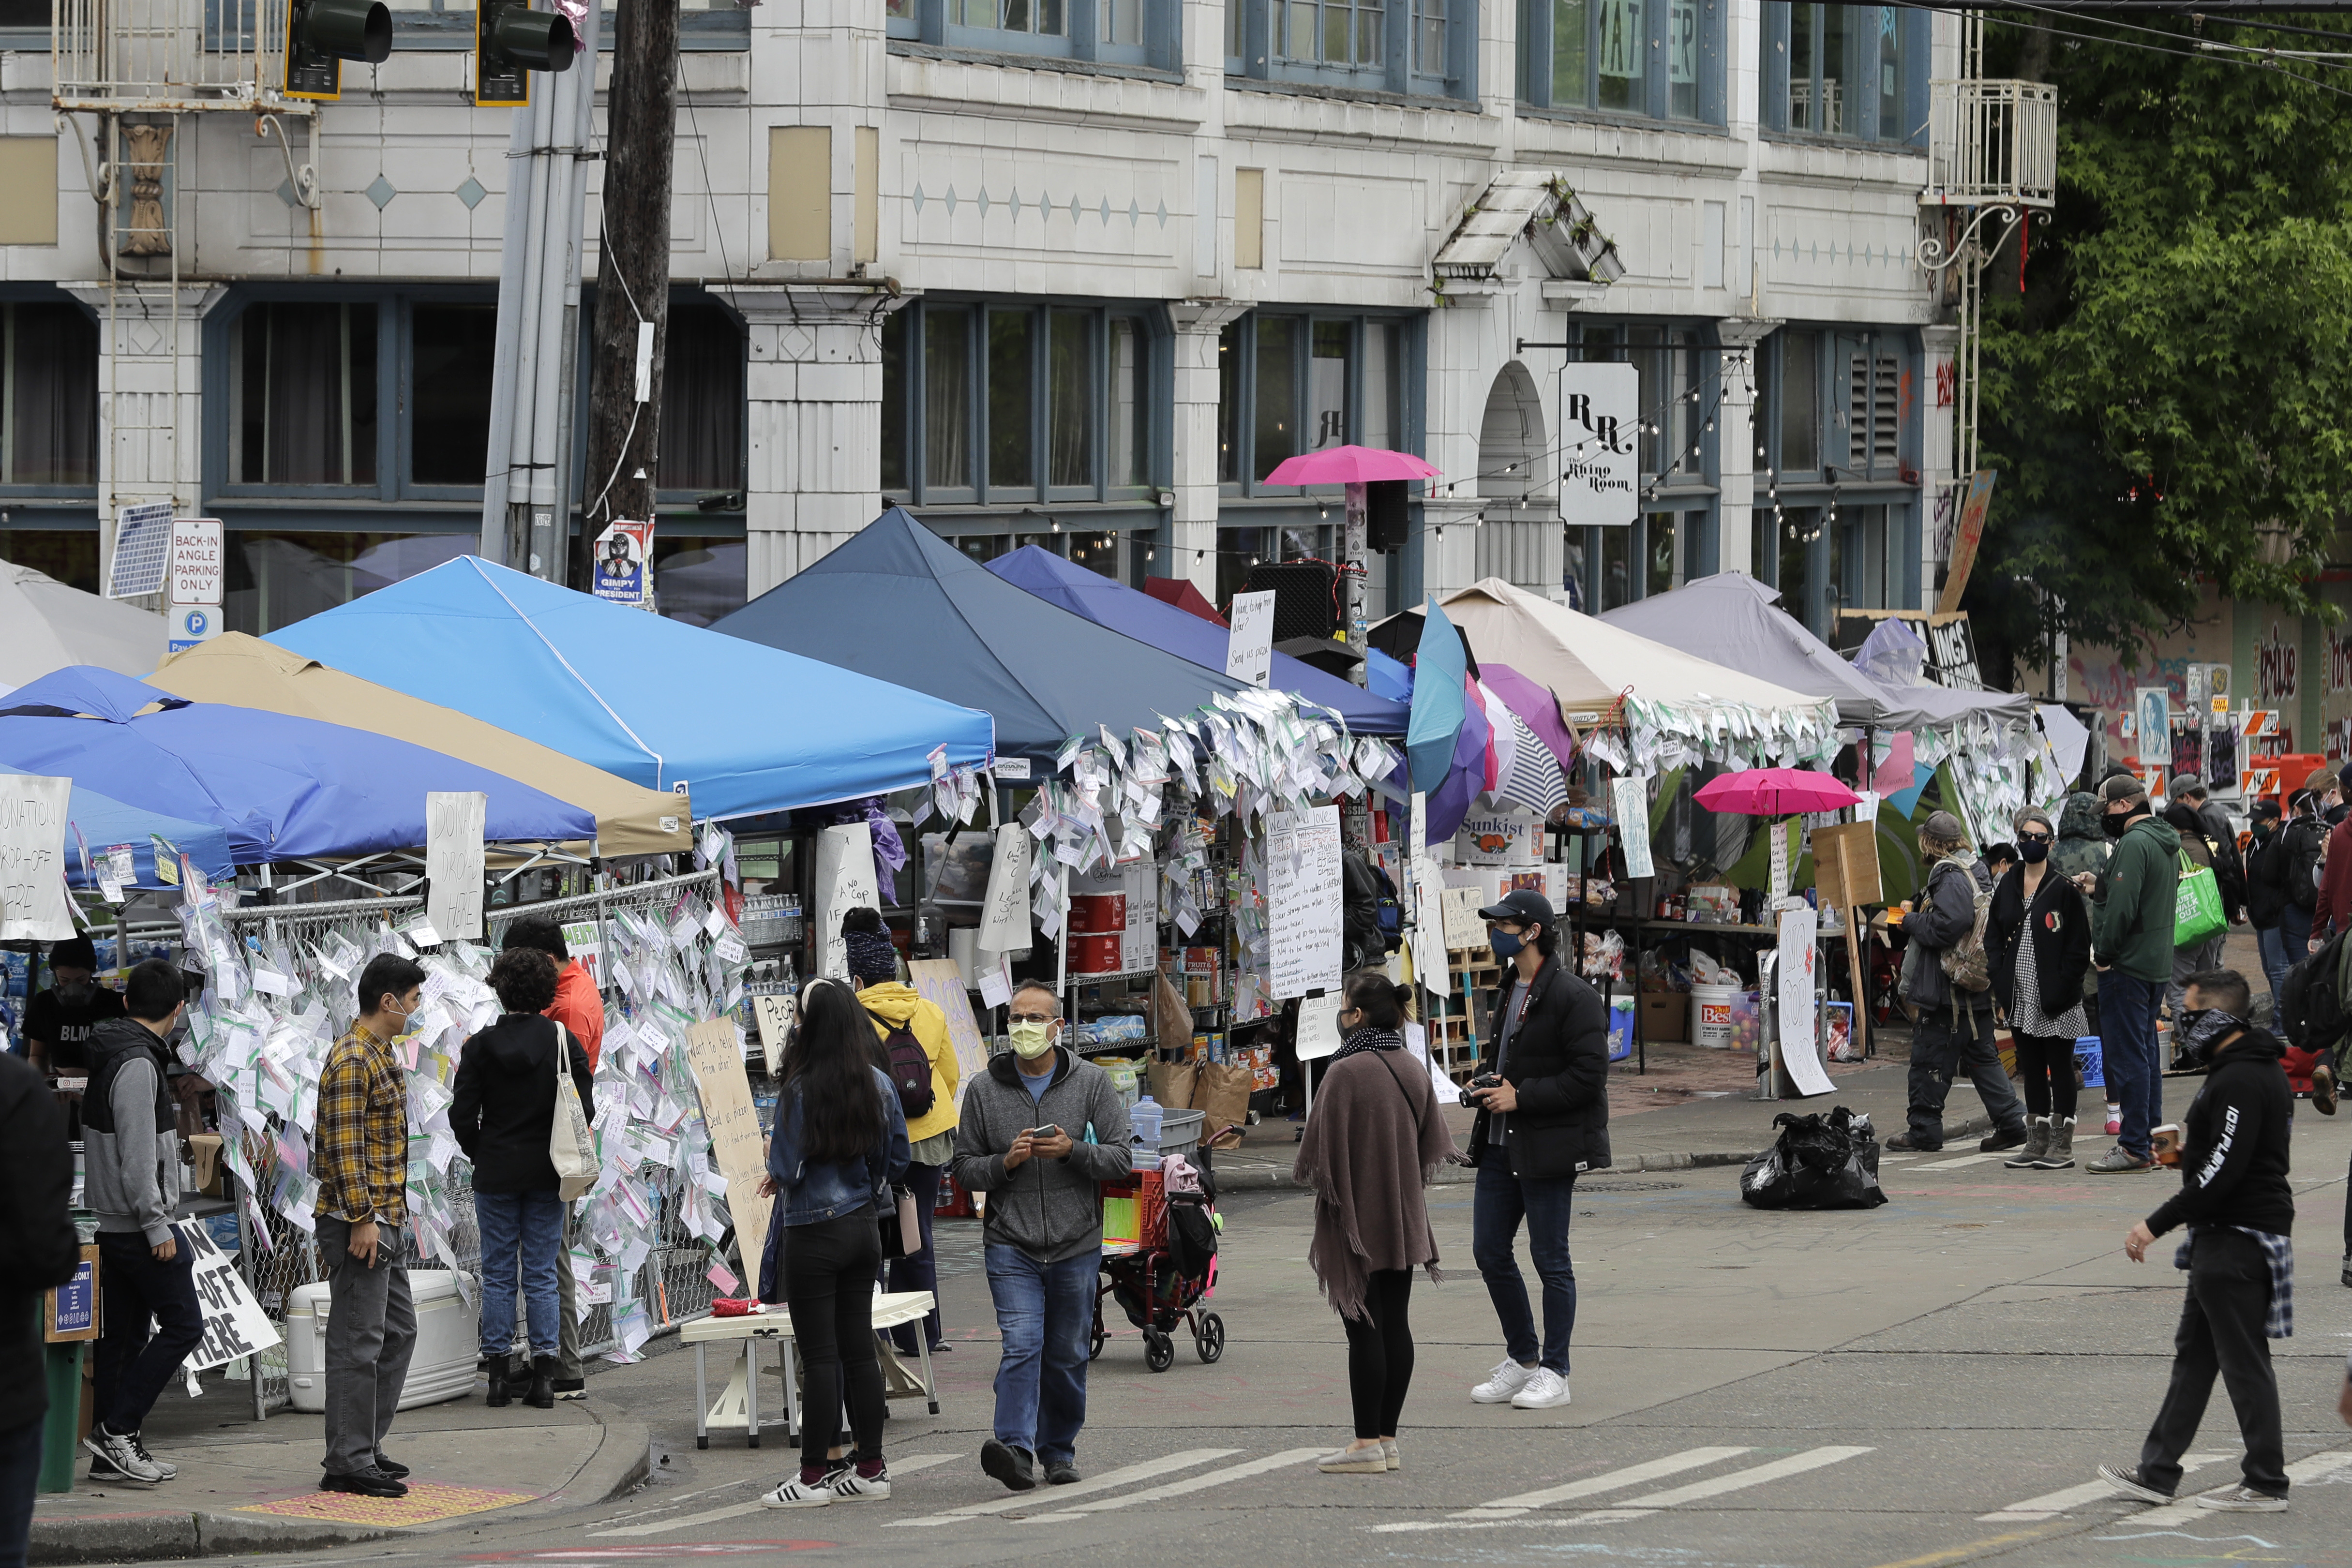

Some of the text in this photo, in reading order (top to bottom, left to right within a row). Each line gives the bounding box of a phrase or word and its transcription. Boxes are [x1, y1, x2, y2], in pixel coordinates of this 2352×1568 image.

[1569, 463, 1611, 479] Rhino
[1589, 477, 1633, 493] Room
[176, 536, 218, 546] BACK-IN
[177, 551, 216, 561] ANGLE
[175, 565, 219, 576] PARKING
[180, 580, 213, 590] ONLY
[601, 579, 635, 587] GIMPY
[595, 589, 640, 600] PRESIDENT
[1235, 598, 1248, 616] Want
[1249, 598, 1254, 612] to
[1230, 650, 1244, 668] Send
[1246, 648, 1254, 659] us
[0, 798, 55, 829] ONATION
[1267, 813, 1282, 833] We
[1461, 817, 1525, 836] Sunkist
[0, 845, 51, 871] ROP-OFF
[1785, 923, 1806, 974] NO
[1308, 997, 1327, 1009] WOULD
[1782, 977, 1807, 1029] COP
[60, 1025, 90, 1041] BLM
[689, 1029, 733, 1059] Want to help
[702, 1056, 733, 1077] from afar?
[705, 1099, 749, 1129] Send us pizza!
[722, 1135, 729, 1149] Or
[731, 1166, 749, 1185] Delivery
[77, 1270, 90, 1281] ONLY
[192, 1313, 255, 1367] HERE
